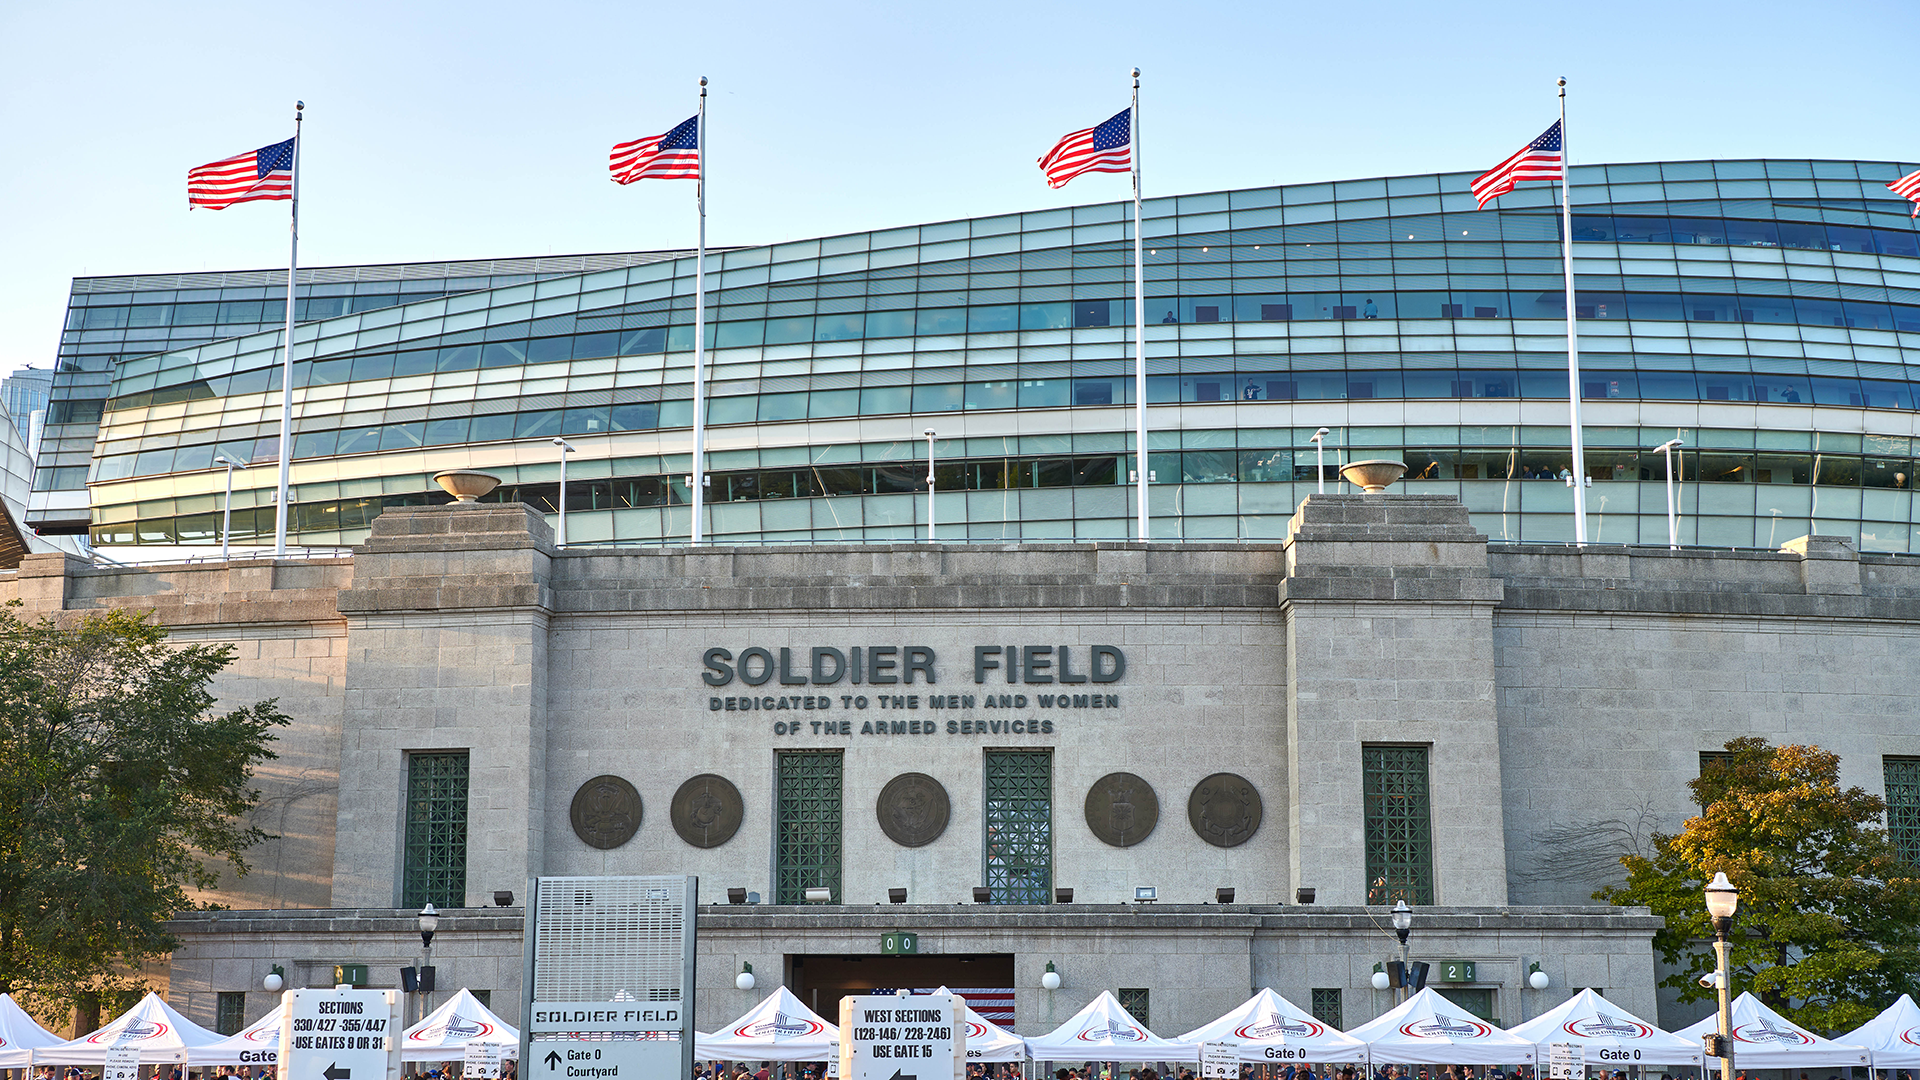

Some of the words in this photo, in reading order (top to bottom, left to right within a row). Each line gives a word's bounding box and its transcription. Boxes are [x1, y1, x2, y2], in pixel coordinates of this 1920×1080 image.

[702, 646, 936, 686] SOLDIER
[974, 645, 1126, 684] FIELD
[709, 695, 831, 711] DEDICATED
[841, 695, 868, 709] TO
[878, 695, 919, 709] THE
[929, 695, 975, 709] MEN
[984, 694, 1028, 709] AND
[1037, 694, 1119, 709] WOMEN
[774, 721, 800, 735] OF
[810, 721, 851, 735] THE
[860, 720, 937, 735] ARMED
[946, 719, 1054, 734] SERVICES
[886, 937, 894, 950] 0
[903, 937, 911, 950] 0
[352, 968, 357, 982] 1
[1448, 965, 1457, 978] 2
[1466, 965, 1472, 978] 2
[318, 1001, 364, 1015] SECTIONS
[535, 1010, 618, 1023] SOLDIER
[623, 1010, 679, 1022] FIELD
[864, 1009, 892, 1023] WEST
[894, 1009, 942, 1023] SECTIONS
[293, 1018, 336, 1032] 330/427
[339, 1018, 387, 1032] -355/447
[854, 1027, 902, 1040] (128-146/
[904, 1027, 951, 1040] 228-246)
[295, 1036, 313, 1049] USE
[315, 1036, 345, 1049] GATES
[347, 1037, 354, 1049] 9
[356, 1037, 369, 1049] OR
[372, 1037, 383, 1049] 31
[239, 1050, 277, 1062] Gate
[567, 1049, 591, 1060] Gate
[595, 1049, 601, 1060] 0
[872, 1045, 891, 1058] USE
[894, 1045, 920, 1058] GATE
[921, 1045, 933, 1058] 15
[965, 1049, 982, 1057] es
[1264, 1047, 1295, 1059] Gate
[1298, 1047, 1306, 1059] 0
[1600, 1048, 1630, 1060] Gate
[1633, 1048, 1641, 1060] 0
[567, 1065, 619, 1078] Courtyard
